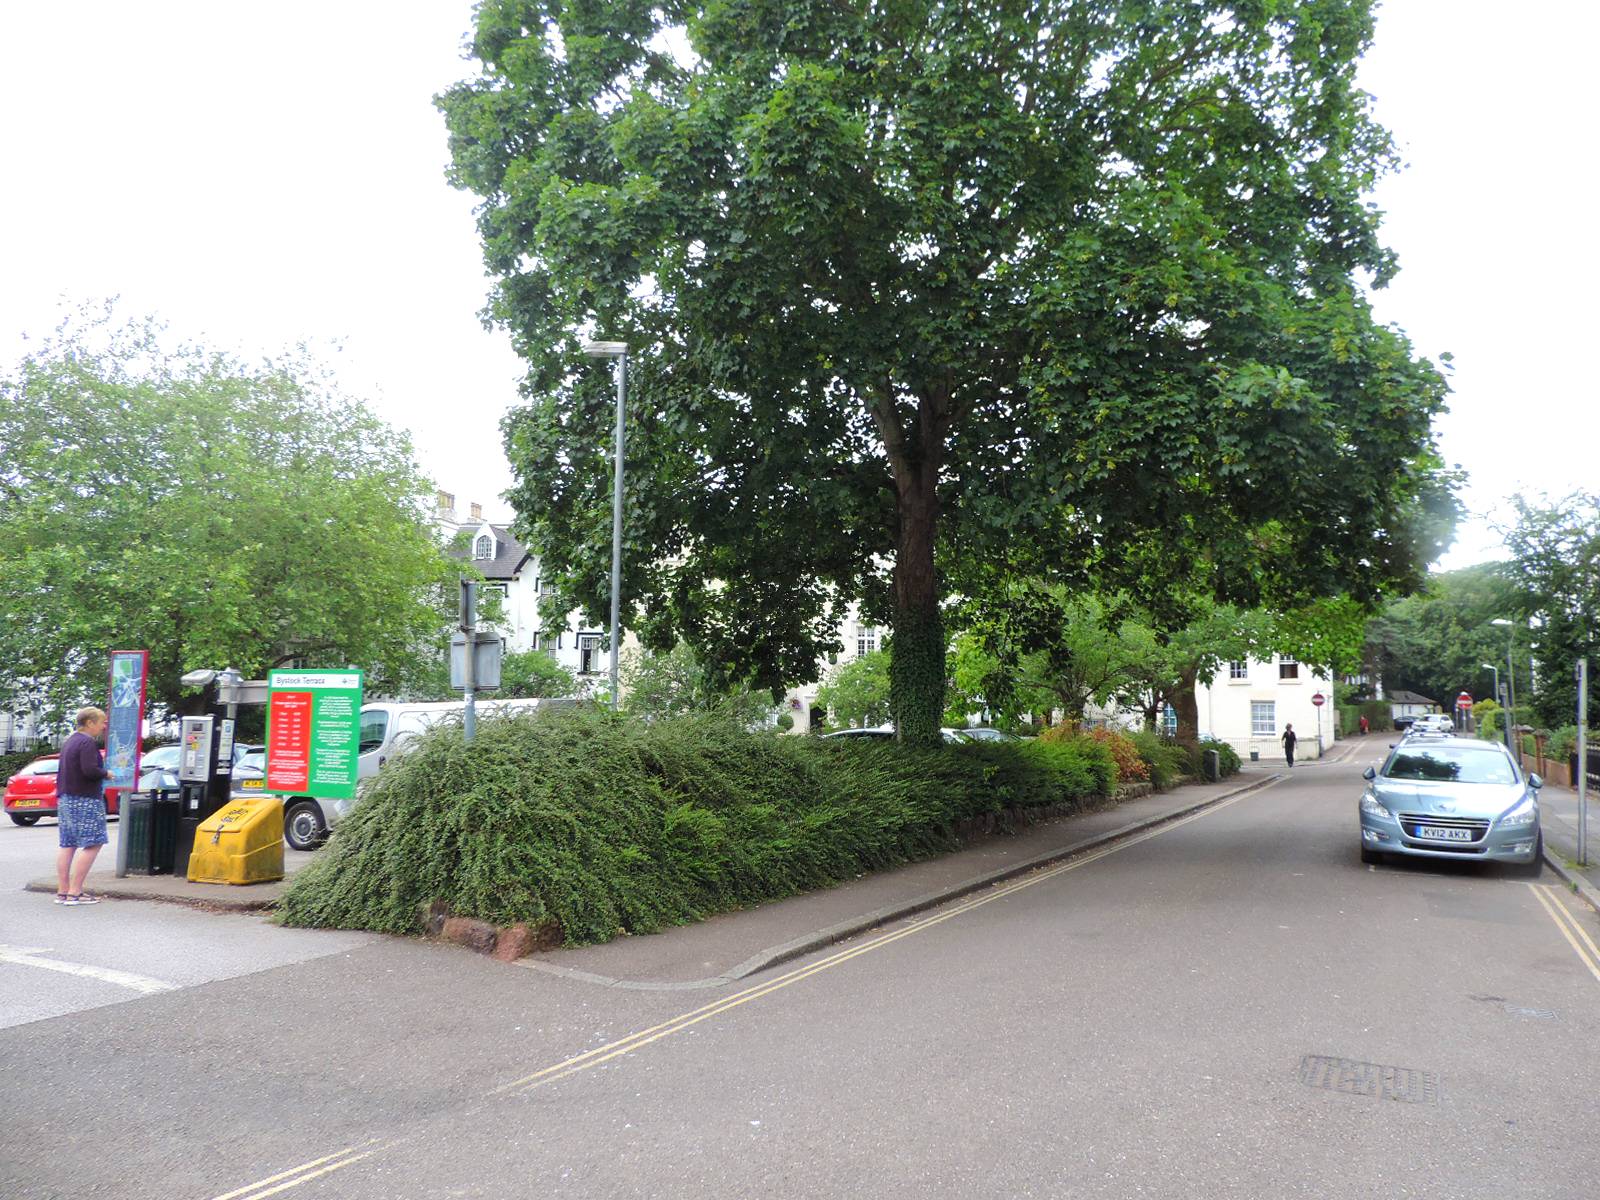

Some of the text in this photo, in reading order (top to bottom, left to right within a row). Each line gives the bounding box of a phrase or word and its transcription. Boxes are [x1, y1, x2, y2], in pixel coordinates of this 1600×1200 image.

[276, 677, 300, 686] Bystock
[1424, 828, 1469, 839] KV12 AKX
